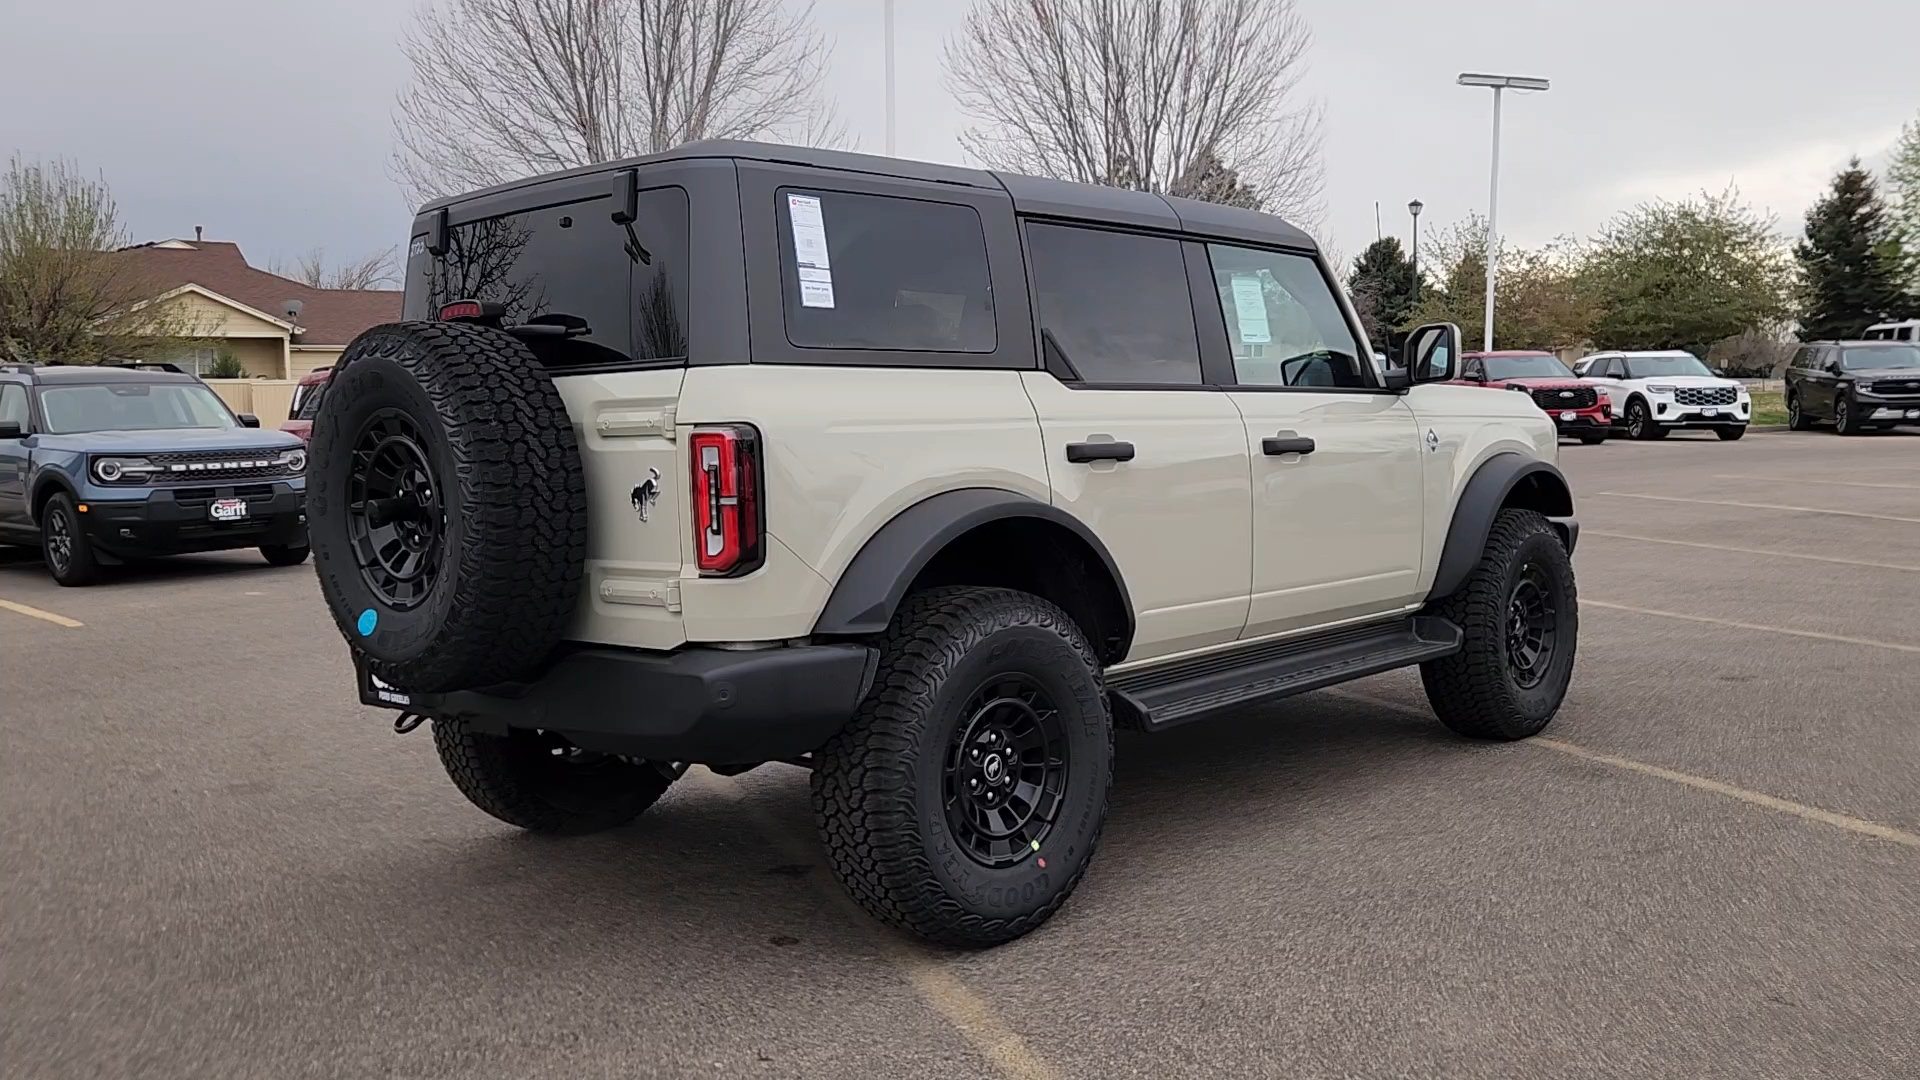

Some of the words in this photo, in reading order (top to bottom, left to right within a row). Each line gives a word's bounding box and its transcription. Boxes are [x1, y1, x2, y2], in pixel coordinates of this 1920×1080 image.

[171, 460, 268, 472] BRONCO
[211, 501, 247, 518] Garff
[928, 810, 1050, 908] GOODYEAR
